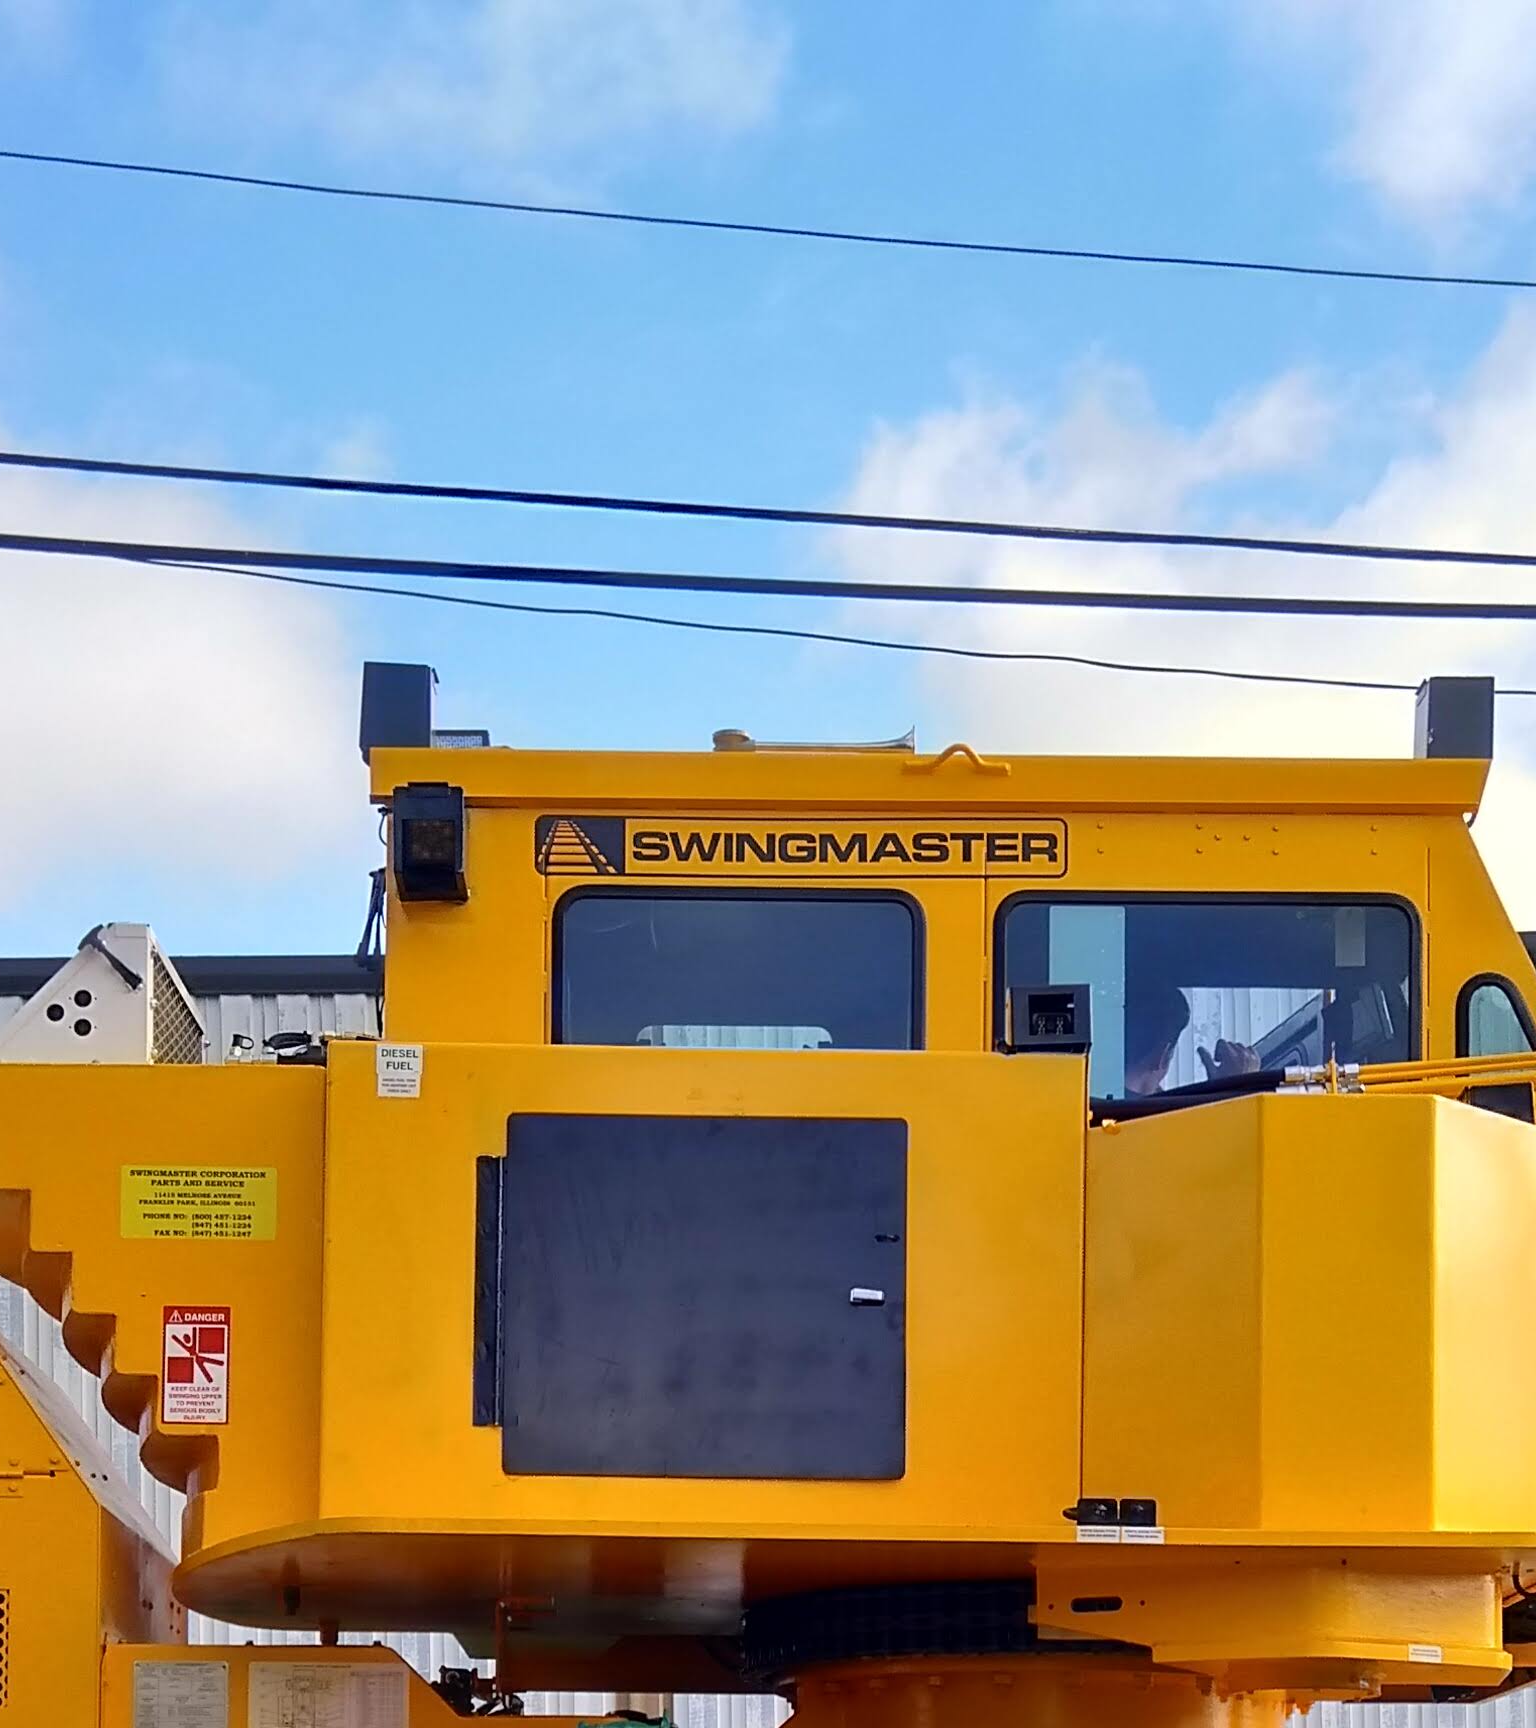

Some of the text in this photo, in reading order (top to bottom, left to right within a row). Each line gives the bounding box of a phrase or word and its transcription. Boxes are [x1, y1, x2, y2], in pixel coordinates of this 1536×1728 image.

[632, 831, 1058, 863] SWINGMASTER
[381, 1048, 419, 1059] DIESEL
[386, 1061, 413, 1071] FUEL
[130, 1169, 266, 1179] SWINGMASTER CORPORATION
[151, 1179, 181, 1187] PARTS
[205, 1180, 245, 1188] SERVICE
[184, 1313, 225, 1322] DANGER
